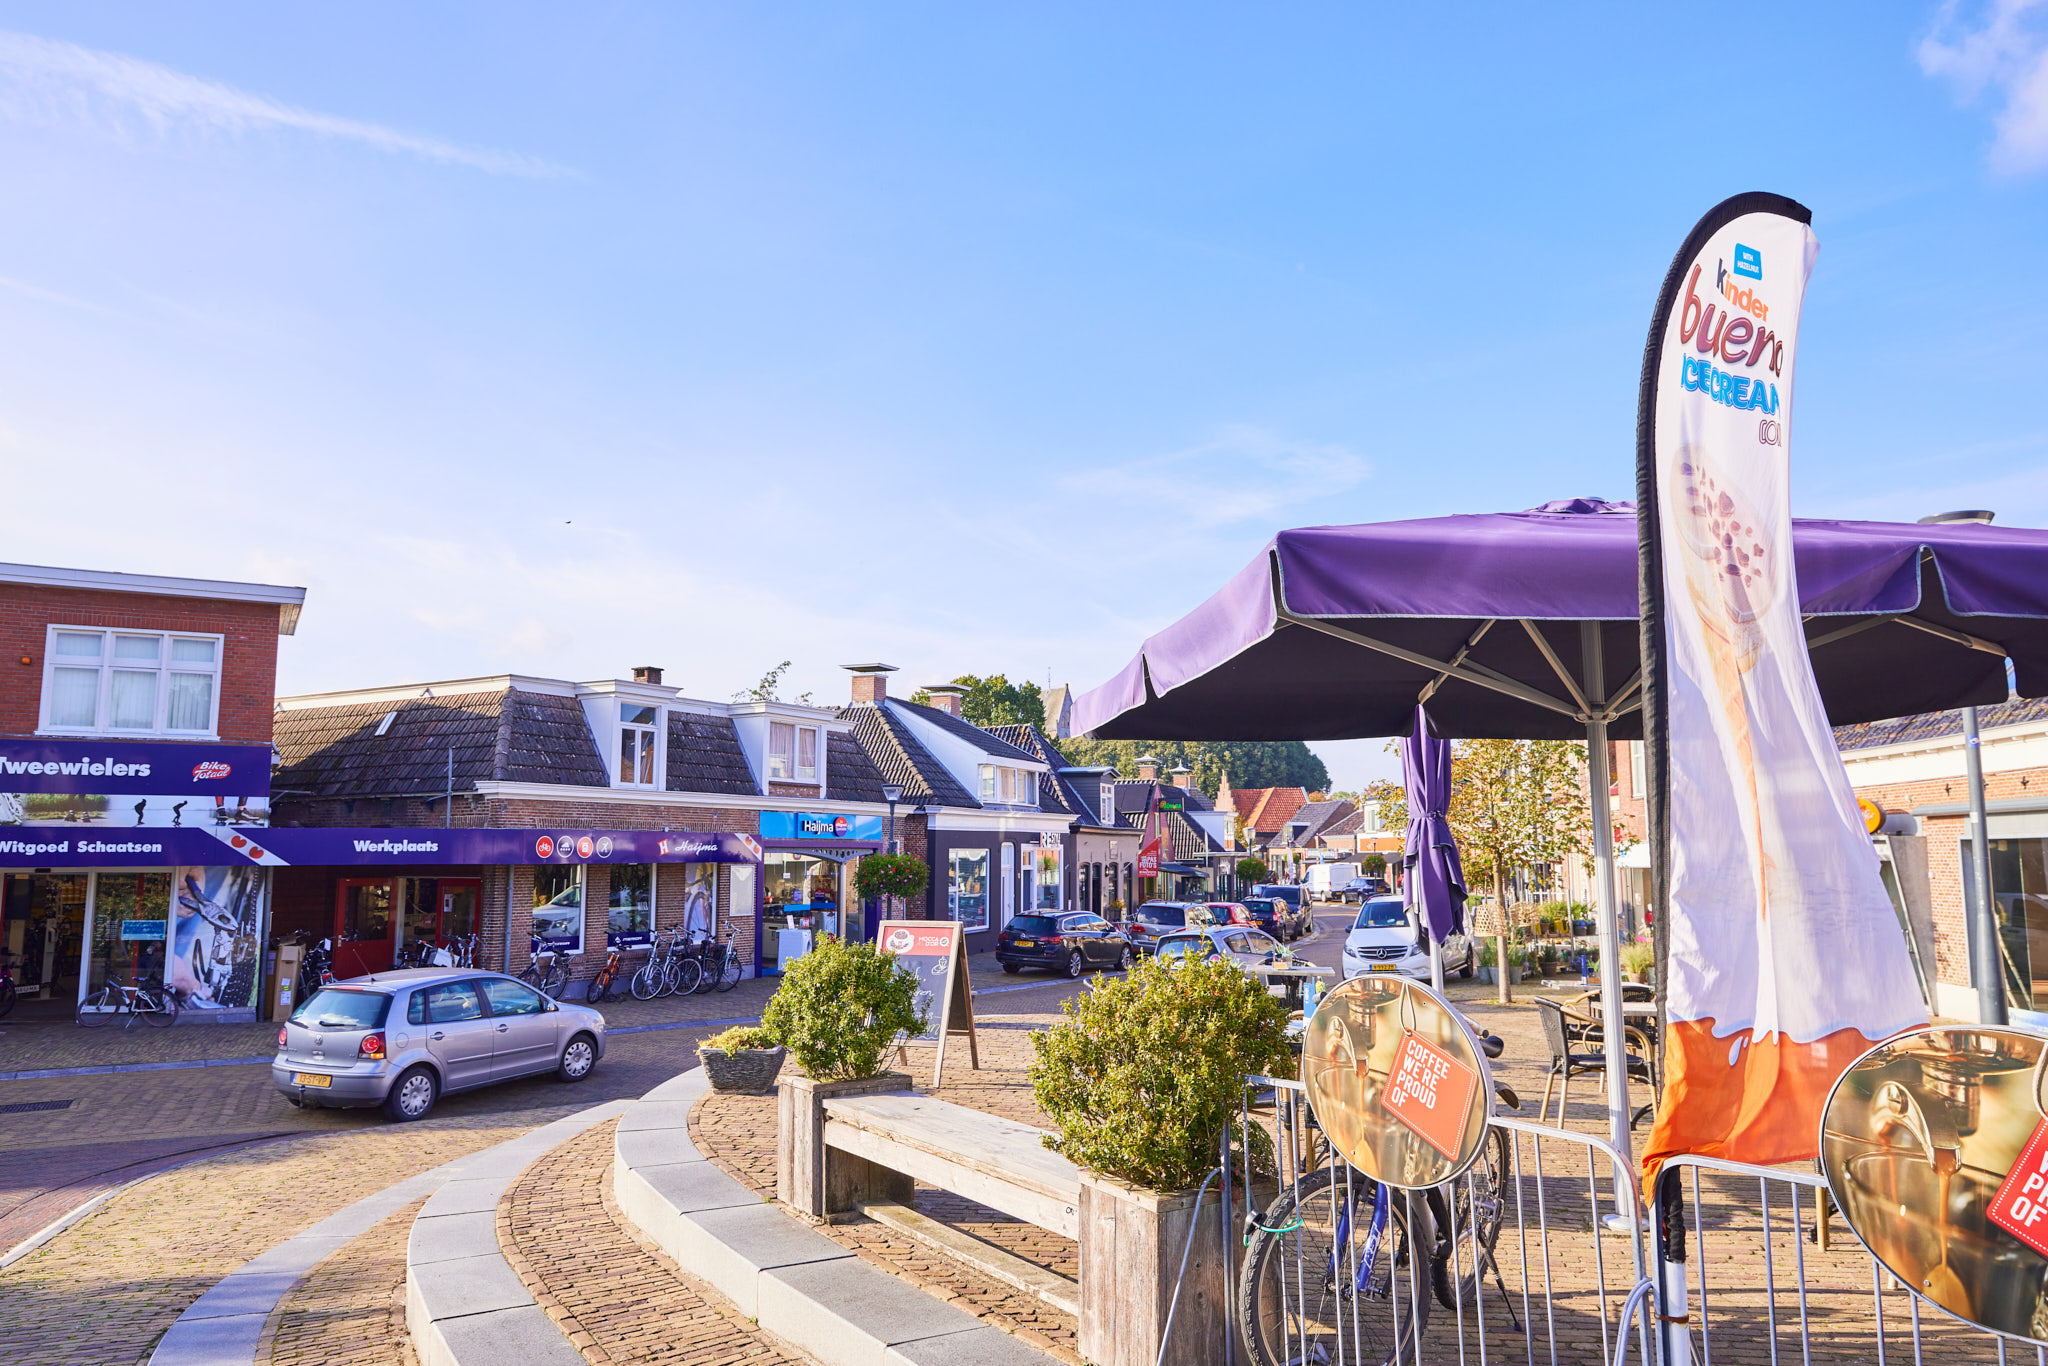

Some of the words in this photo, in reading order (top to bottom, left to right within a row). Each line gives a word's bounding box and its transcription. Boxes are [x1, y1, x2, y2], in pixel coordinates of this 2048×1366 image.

[1717, 258, 1769, 322] kinder
[1680, 264, 1783, 377] bueno
[200, 761, 228, 770] Bike
[193, 767, 231, 782] Totaal
[804, 820, 834, 835] Haijma
[0, 841, 69, 855] Witgoed
[77, 841, 162, 853] Schaatsen
[353, 840, 438, 854] Werkplaats
[675, 840, 718, 856] Haijma
[1407, 1039, 1450, 1080] COFFEE
[300, 1074, 327, 1084] 13-ST-VP
[1403, 1053, 1440, 1092] WE'RE
[1391, 1089, 1408, 1108] OF
[1396, 1070, 1436, 1110] PROUD
[2010, 1196, 2048, 1227] OF
